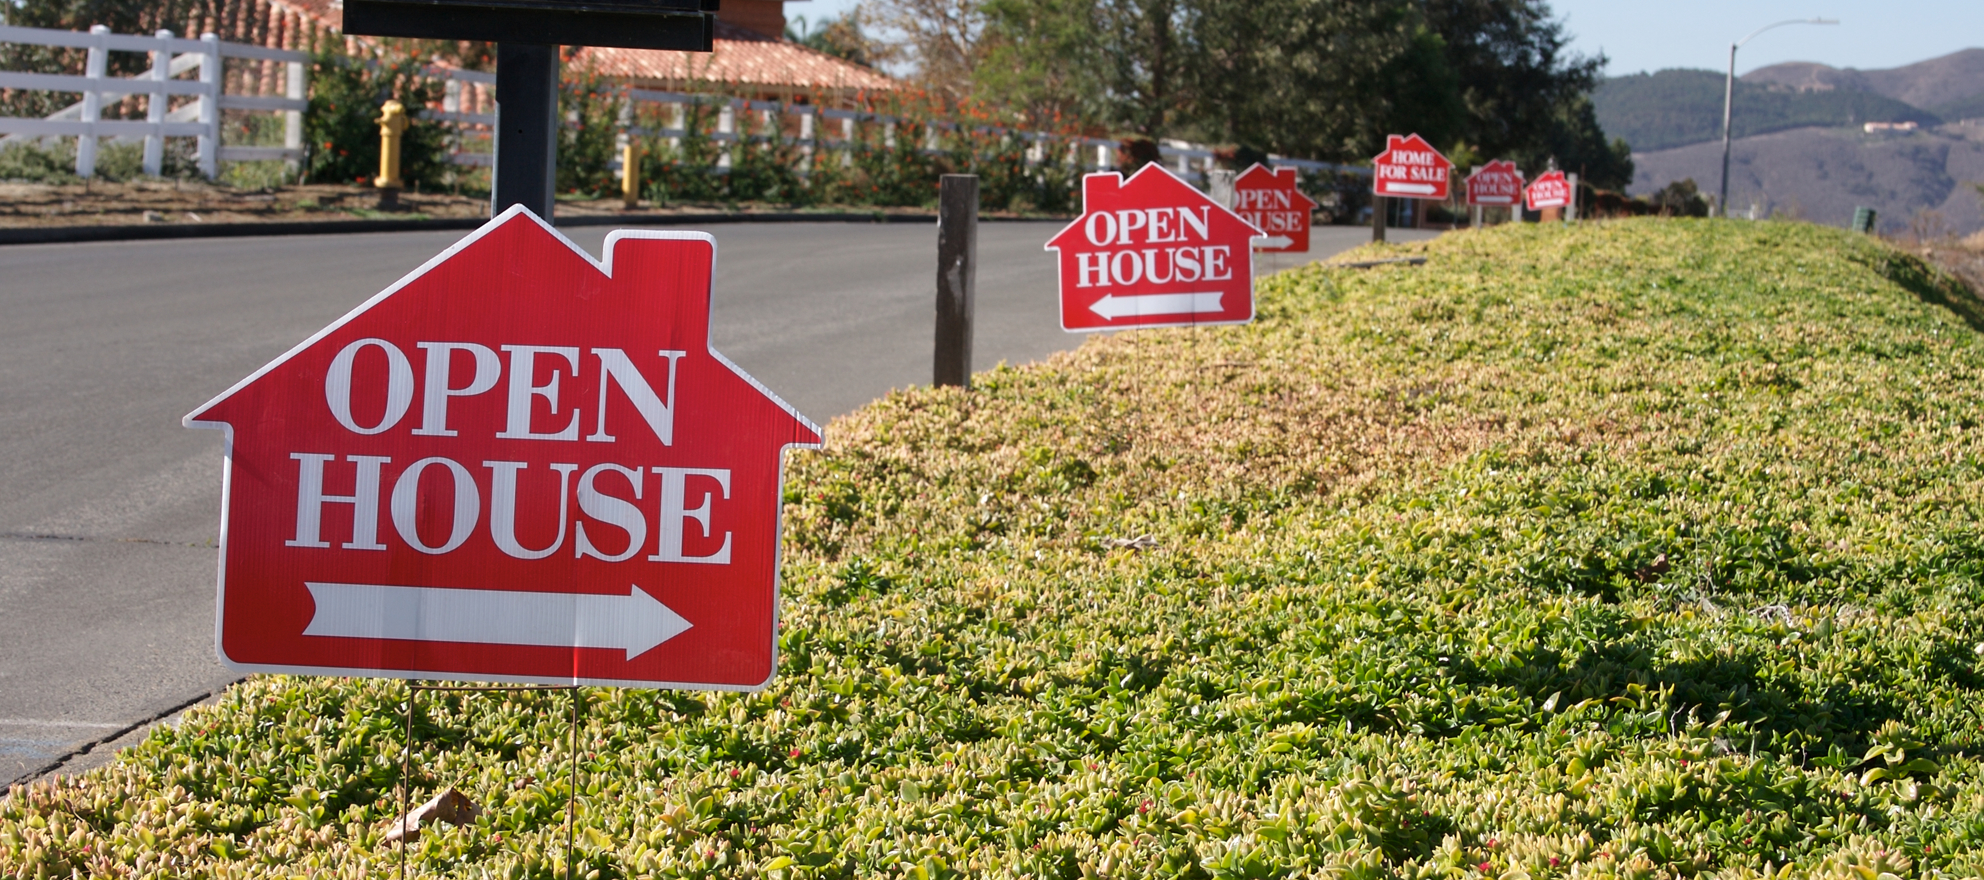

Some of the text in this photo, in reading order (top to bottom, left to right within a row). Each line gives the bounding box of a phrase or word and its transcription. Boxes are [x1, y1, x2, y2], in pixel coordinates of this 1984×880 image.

[1392, 150, 1435, 166] HOME
[1380, 164, 1446, 182] FOR SALE
[1477, 172, 1513, 182] OPEN
[1474, 183, 1518, 194] HOUSE
[1235, 189, 1292, 210] PEN
[1085, 206, 1210, 246] OPEN
[1075, 246, 1232, 288] HOUSE
[324, 338, 686, 446] OPEN
[285, 452, 732, 565] HOUSE
